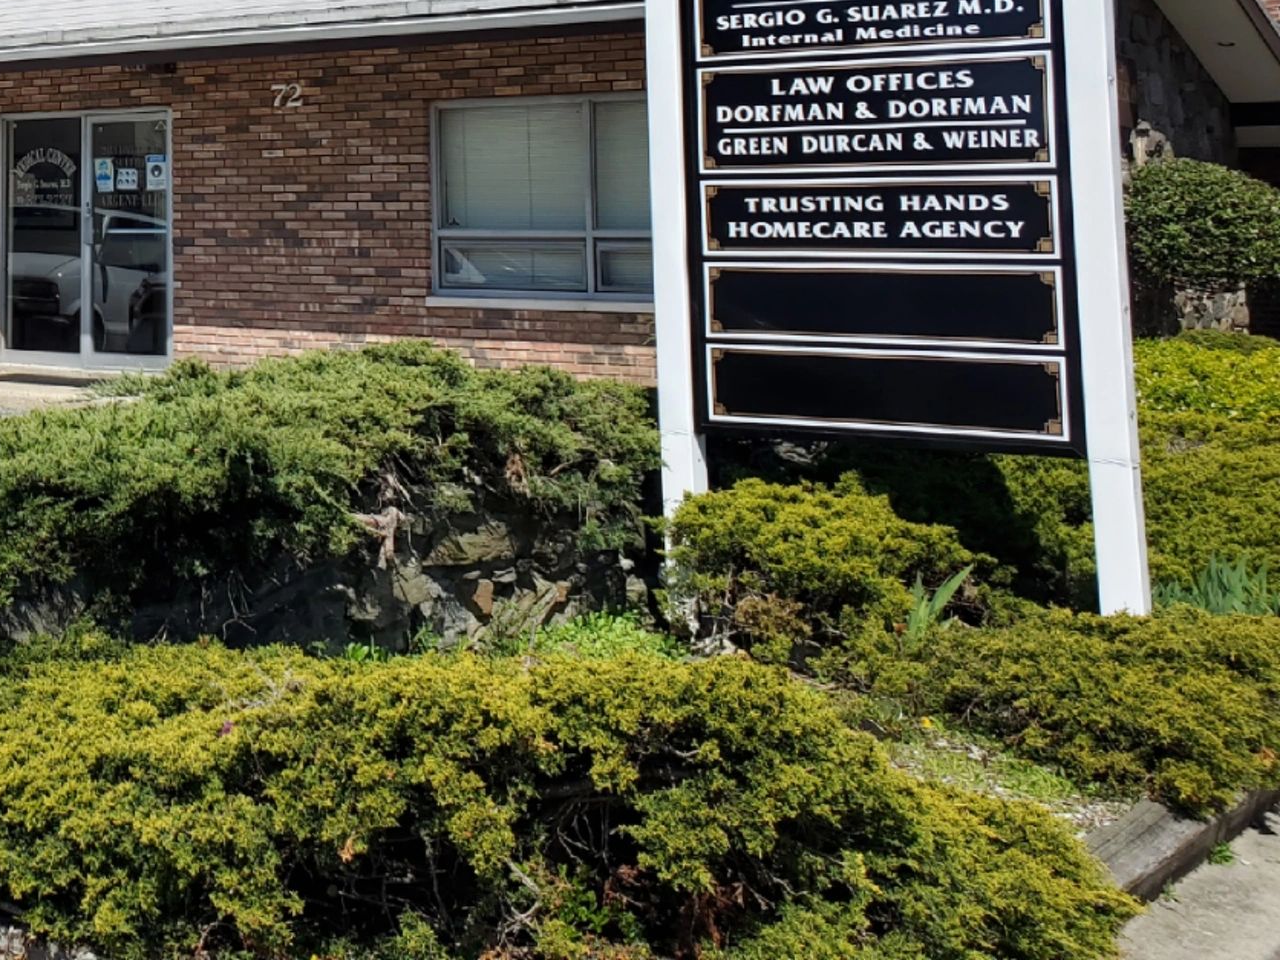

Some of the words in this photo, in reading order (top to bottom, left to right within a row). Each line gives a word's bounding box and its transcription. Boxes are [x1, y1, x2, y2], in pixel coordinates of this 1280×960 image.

[716, 10, 806, 30] SERGIO
[816, 7, 839, 24] G.
[847, 1, 947, 22] SUAREZ
[742, 28, 843, 48] Internal
[855, 21, 980, 40] Medicine
[271, 83, 304, 107] 72
[770, 76, 834, 96] LAW
[846, 70, 974, 93] OFFICES
[716, 102, 844, 123] DORFMAN
[855, 102, 876, 119] &
[887, 94, 1032, 119] DORFMAN
[717, 137, 788, 156] GREEN
[802, 132, 903, 154] DURCAN
[913, 132, 933, 150] &
[942, 129, 1040, 149] WEINER
[744, 195, 884, 214] TRUSTING
[899, 194, 1010, 212] HANDS
[728, 221, 888, 239] HOMECARE
[899, 220, 1025, 239] AGENCY
